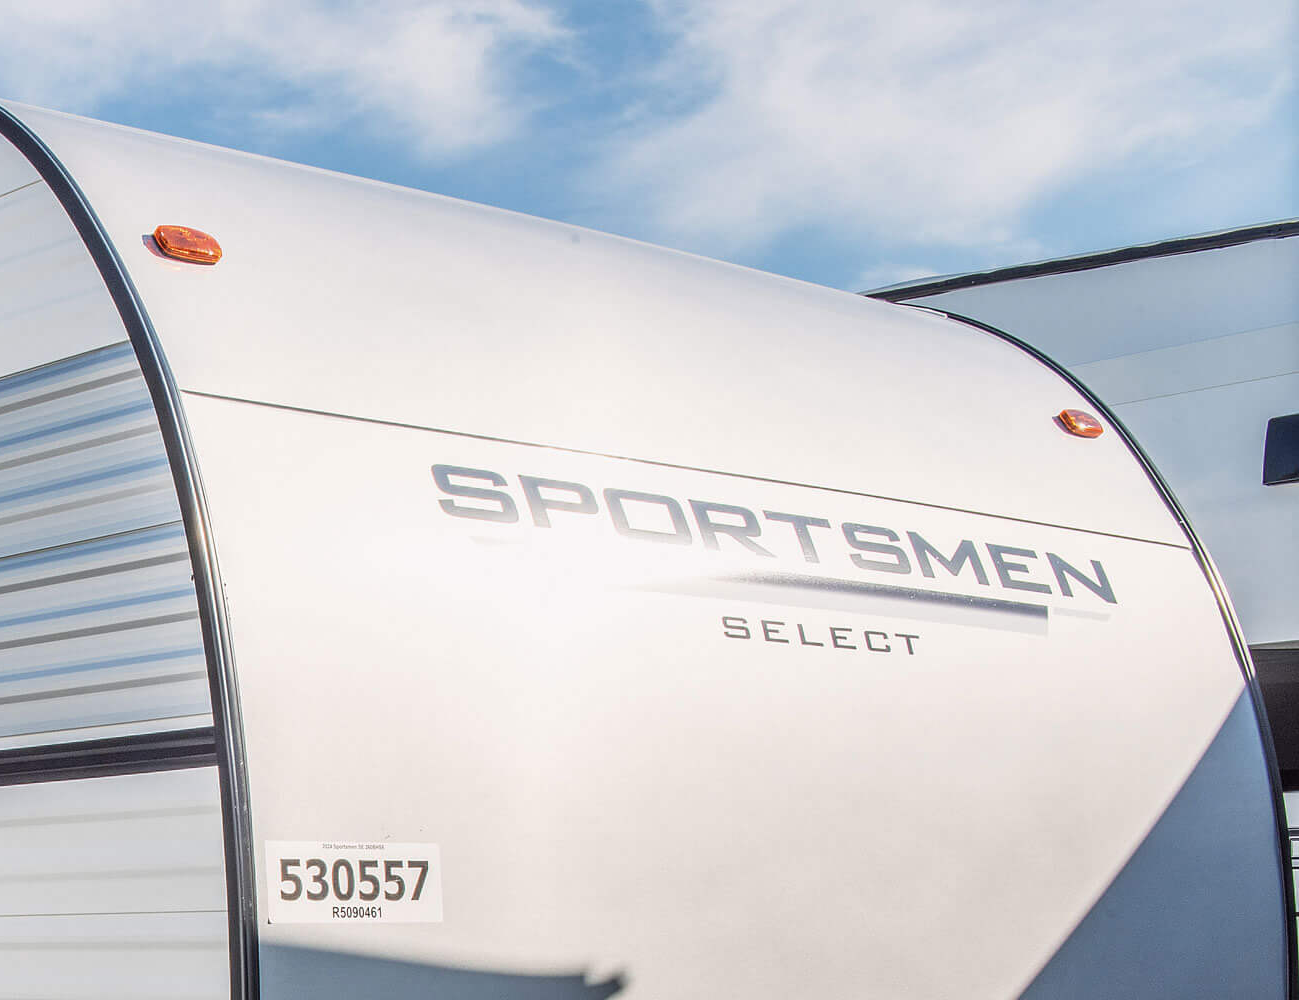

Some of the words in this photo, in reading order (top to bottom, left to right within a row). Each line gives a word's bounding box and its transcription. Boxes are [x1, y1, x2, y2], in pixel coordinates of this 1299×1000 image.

[430, 463, 1118, 604] SPORTSMEN
[722, 616, 920, 655] SELECT
[280, 858, 429, 901] 530557
[332, 906, 382, 918] R5090461
